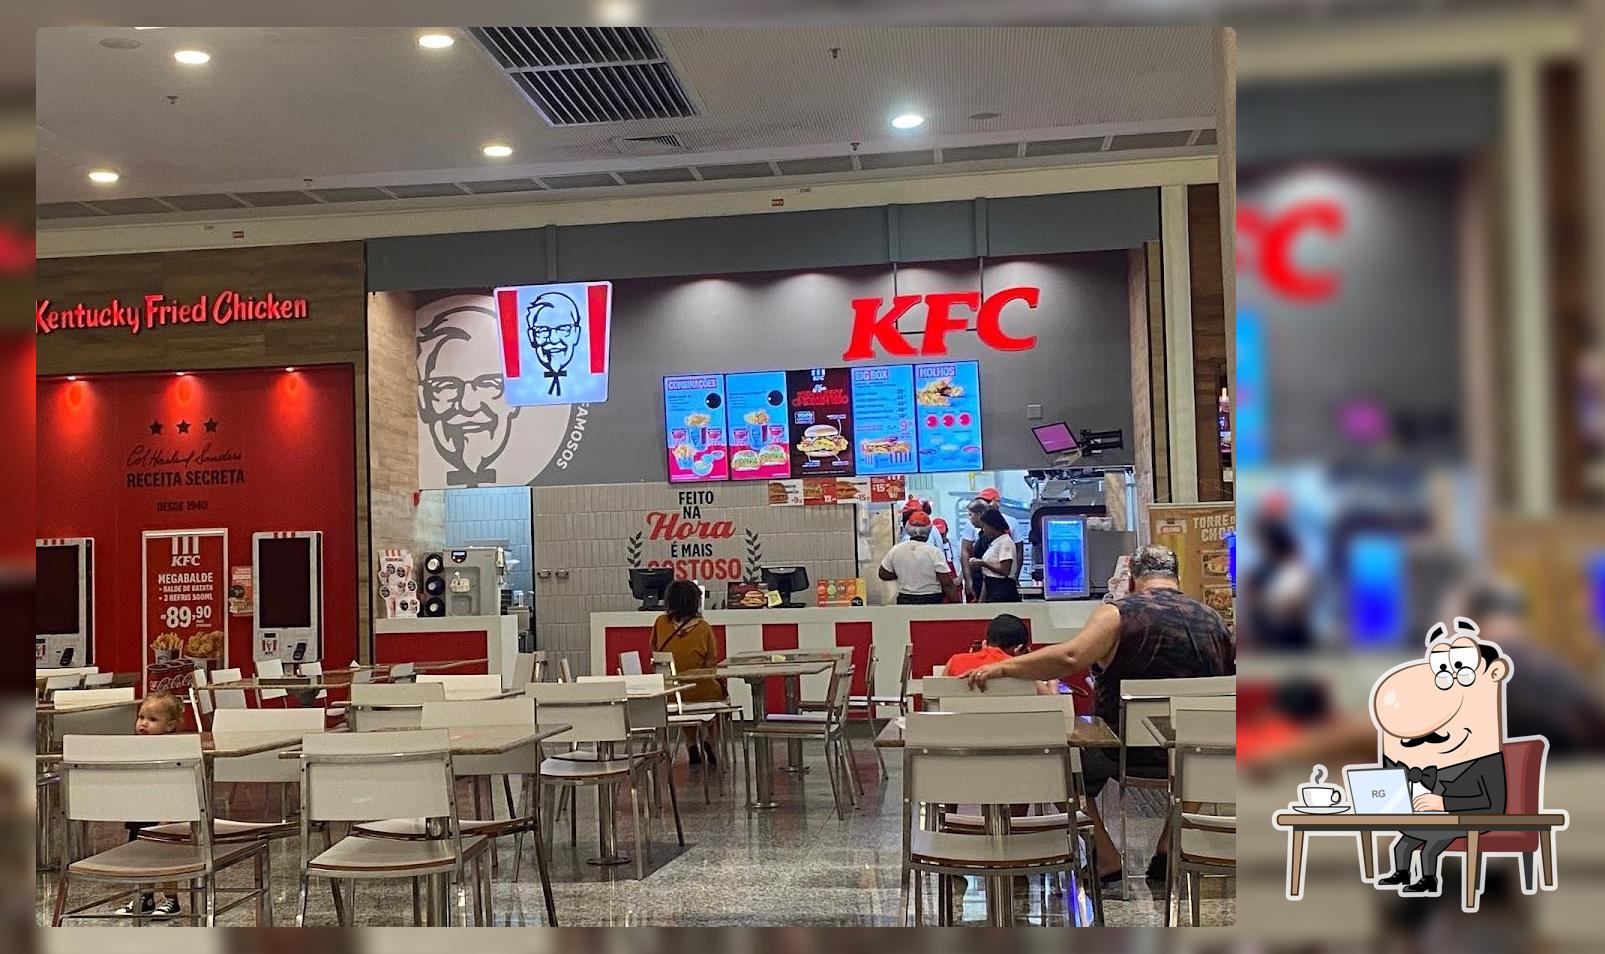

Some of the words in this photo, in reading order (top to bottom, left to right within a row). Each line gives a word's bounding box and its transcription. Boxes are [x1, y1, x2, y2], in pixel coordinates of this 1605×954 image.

[35, 299, 139, 334] Kentucky
[144, 294, 207, 329] Fried
[212, 290, 308, 325] Chicken
[843, 287, 1040, 361] KFC
[855, 371, 869, 380] BIG
[871, 369, 888, 380] BOX
[920, 366, 955, 378] MOLHOS
[127, 471, 181, 488] RECEITA
[186, 469, 245, 486] SECRETA
[679, 491, 714, 505] FEITO
[156, 502, 185, 512] DESDE
[187, 500, 208, 511] 1940
[683, 505, 701, 519] NA
[645, 511, 737, 541] Hora
[1193, 514, 1229, 528] TORRE
[671, 541, 678, 558] É
[682, 543, 713, 558] MAIS
[171, 555, 200, 567] KFC
[158, 573, 214, 584] MEGABALDE
[163, 585, 182, 593] BALDE
[191, 584, 213, 592] BATATA
